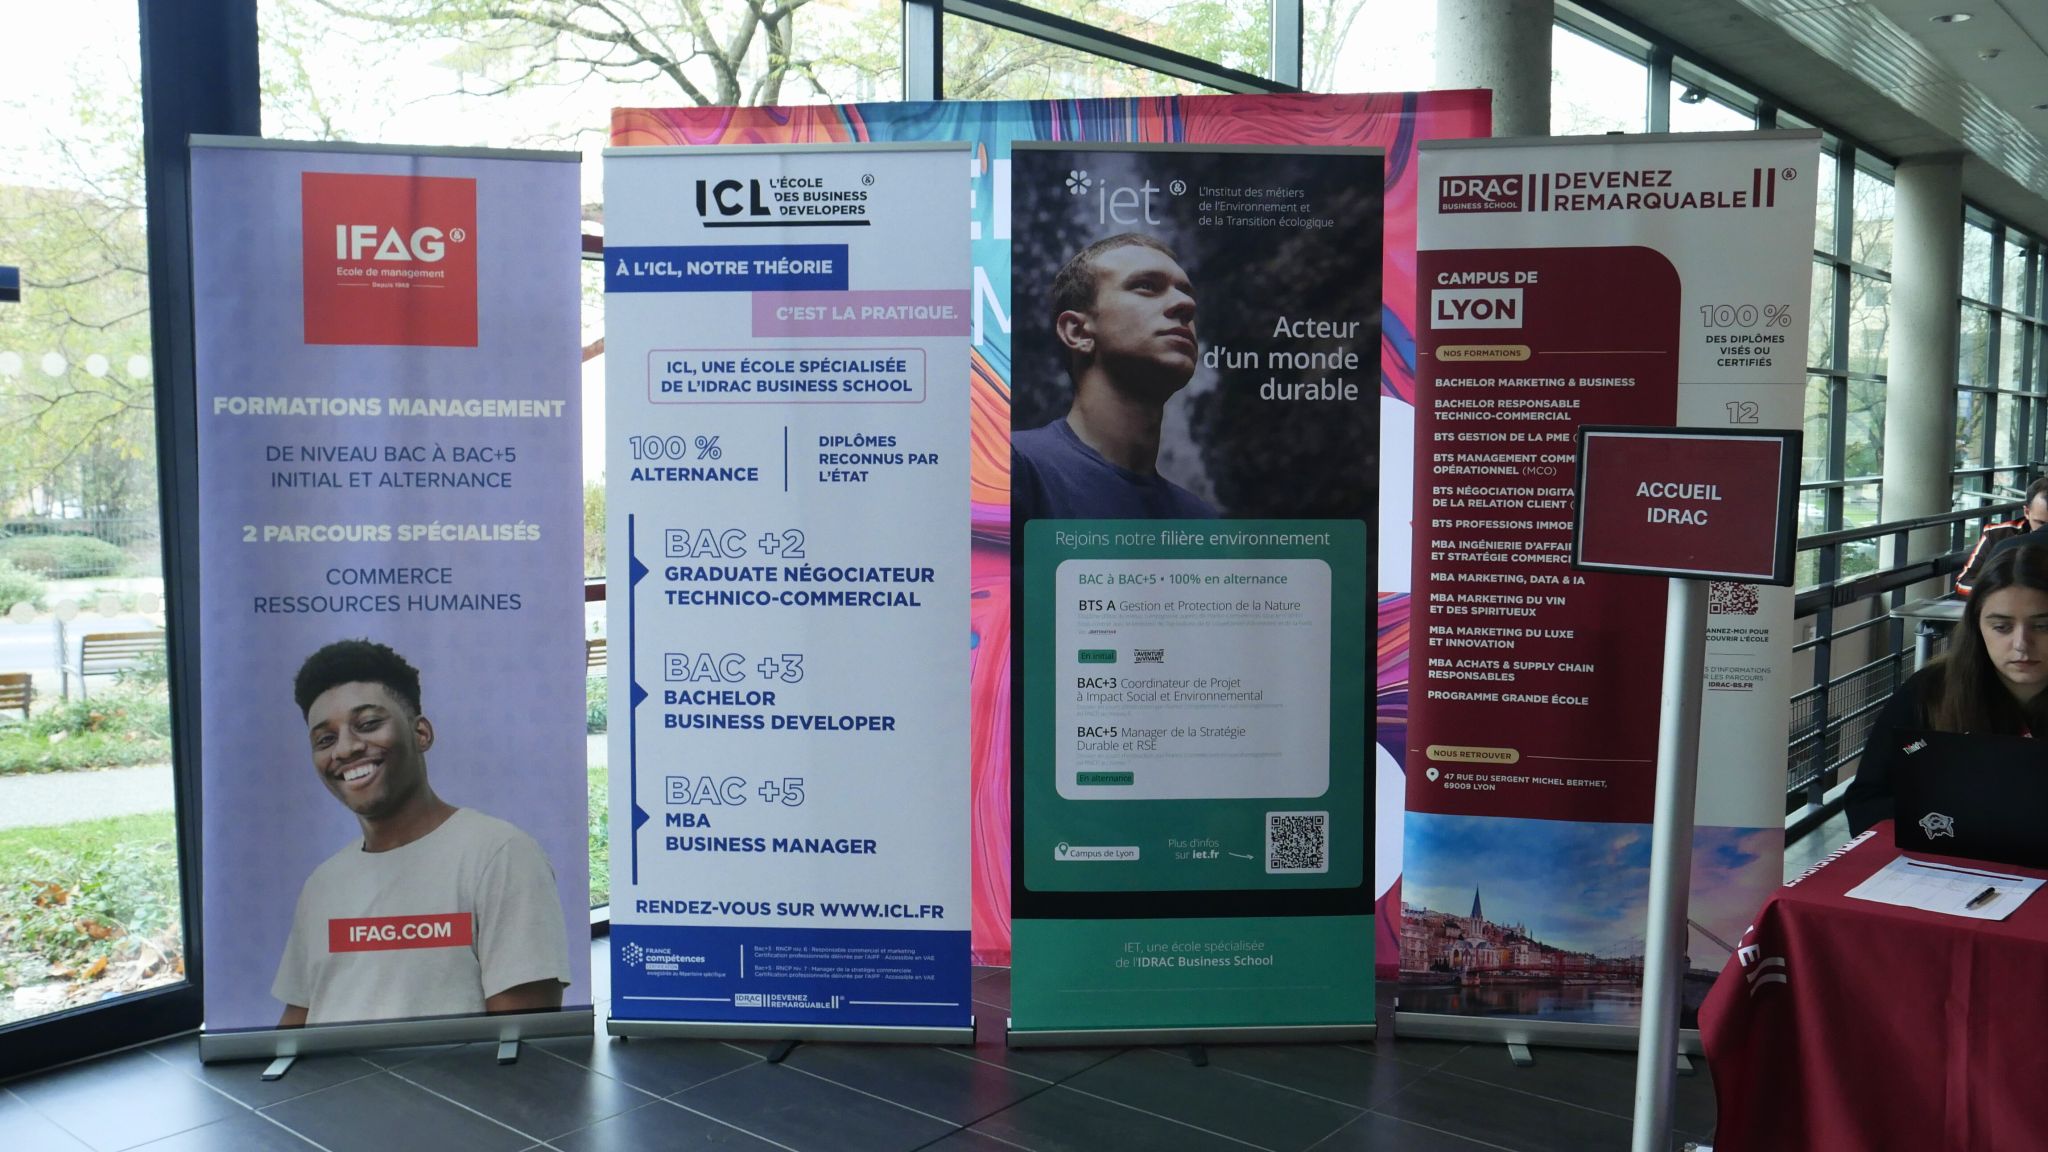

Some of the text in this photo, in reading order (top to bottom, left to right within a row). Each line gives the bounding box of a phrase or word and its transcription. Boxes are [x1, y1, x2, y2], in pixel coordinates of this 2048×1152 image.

[769, 176, 822, 188] L'ÉCOLE
[1555, 170, 1672, 189] DEVENEZ
[774, 191, 867, 202] DES BUSINESS
[1244, 187, 1263, 197] des
[1265, 186, 1304, 198] métiers
[1442, 178, 1518, 200] IDRAC
[696, 179, 771, 216] ICL
[1554, 191, 1746, 210] REMARQUABLE
[779, 204, 865, 215] DEVELOPERS
[1198, 200, 1212, 211] de
[1300, 203, 1310, 212] et
[1442, 202, 1481, 210] BUSINESS
[1198, 215, 1334, 230] de la Transition écologique
[336, 224, 445, 262] IFAG
[336, 266, 444, 278] Ecole de management
[615, 257, 832, 277] À L'ICL, NOTRE THÉORIE
[1437, 271, 1537, 284] CAMPUS DE
[775, 305, 957, 320] C'EST LA PRATIQUE.
[1438, 298, 1515, 320] LYON
[1699, 304, 1758, 327] 100
[1272, 316, 1359, 338] Acteur
[1705, 333, 1784, 343] DES DIPLÔMES
[1203, 345, 1358, 370] d'un monde
[1719, 345, 1770, 358] VISÉS OU
[667, 357, 906, 375] ICL, UNE ÉCOLE SPÉCIALISÉE
[1716, 357, 1772, 366] CERTIFIÉS
[661, 379, 912, 392] DE L'IDRAC BUSINESS SCHOOL
[1260, 377, 1358, 400] durable
[1434, 378, 1495, 387] BACHELOR
[1498, 378, 1565, 386] MARKETING
[1578, 377, 1635, 386] BUSINESS
[211, 395, 565, 417] FORMATIONS MANAGEMENT
[1434, 399, 1580, 408] BACHELOR RESPONSABLE
[1434, 411, 1571, 420] TECHNICO-COMMERCIAL
[1725, 401, 1758, 424] 12
[629, 435, 686, 460] 100
[819, 433, 896, 447] DIPLÔMES
[263, 443, 516, 463] DE NIVEAU BAC À BAC+5
[819, 453, 938, 464] RECONNUS PAR
[630, 467, 758, 481] ALTERNANCE
[819, 468, 868, 482] L'ÉTAT
[1432, 464, 1556, 475] OPÉRATIONNEL (MCO)
[268, 471, 511, 489] INITIAL ET ALTERNANCE
[1636, 481, 1722, 502] ACCUEIL
[1647, 507, 1708, 526] IDRAC
[243, 520, 540, 542] 2 PARCOURS SPÉCIALISÉS
[665, 528, 805, 558] BAC +2
[1055, 530, 1330, 549] Rejoins notre filière environnement
[325, 567, 452, 585] COMMERCE
[664, 563, 935, 583] GRADUATE NÉGOCIATEUR
[1079, 573, 1287, 584] BAC à BAC+5 100% en alternance
[1430, 572, 1455, 581] MBA
[1457, 573, 1527, 584] MARKETING,
[1529, 575, 1559, 584] DATA
[1573, 576, 1585, 584] IA
[251, 593, 521, 613] RESSOURCES HUMAINES
[664, 590, 921, 606] TECHNICO-COMMERCIAL
[664, 652, 804, 683] BAC +3
[1077, 677, 1240, 690] BAC+3 Coordinateur de Projet
[664, 690, 775, 705] BACHELOR
[1427, 690, 1588, 705] PROGRAMME GRANDE ÉCOLE
[664, 713, 895, 730] BUSINESS DEVELOPER
[1433, 750, 1511, 759] NOUS RETROUVER
[1444, 773, 1607, 787] 47 RUE DU SERGENT MICHEL BERTHET,
[665, 775, 804, 807] BAC +5
[665, 812, 711, 827] MBA
[666, 836, 876, 854] BUSINESS MANAGER
[1070, 849, 1134, 859] Campus de Lyon
[636, 900, 944, 918] RENDEZ-VOUS SUR WWW.ICL.FR
[349, 922, 451, 941] IFAG.COM
[645, 954, 705, 964] compétences
[769, 994, 810, 1003] DEVENEZ
